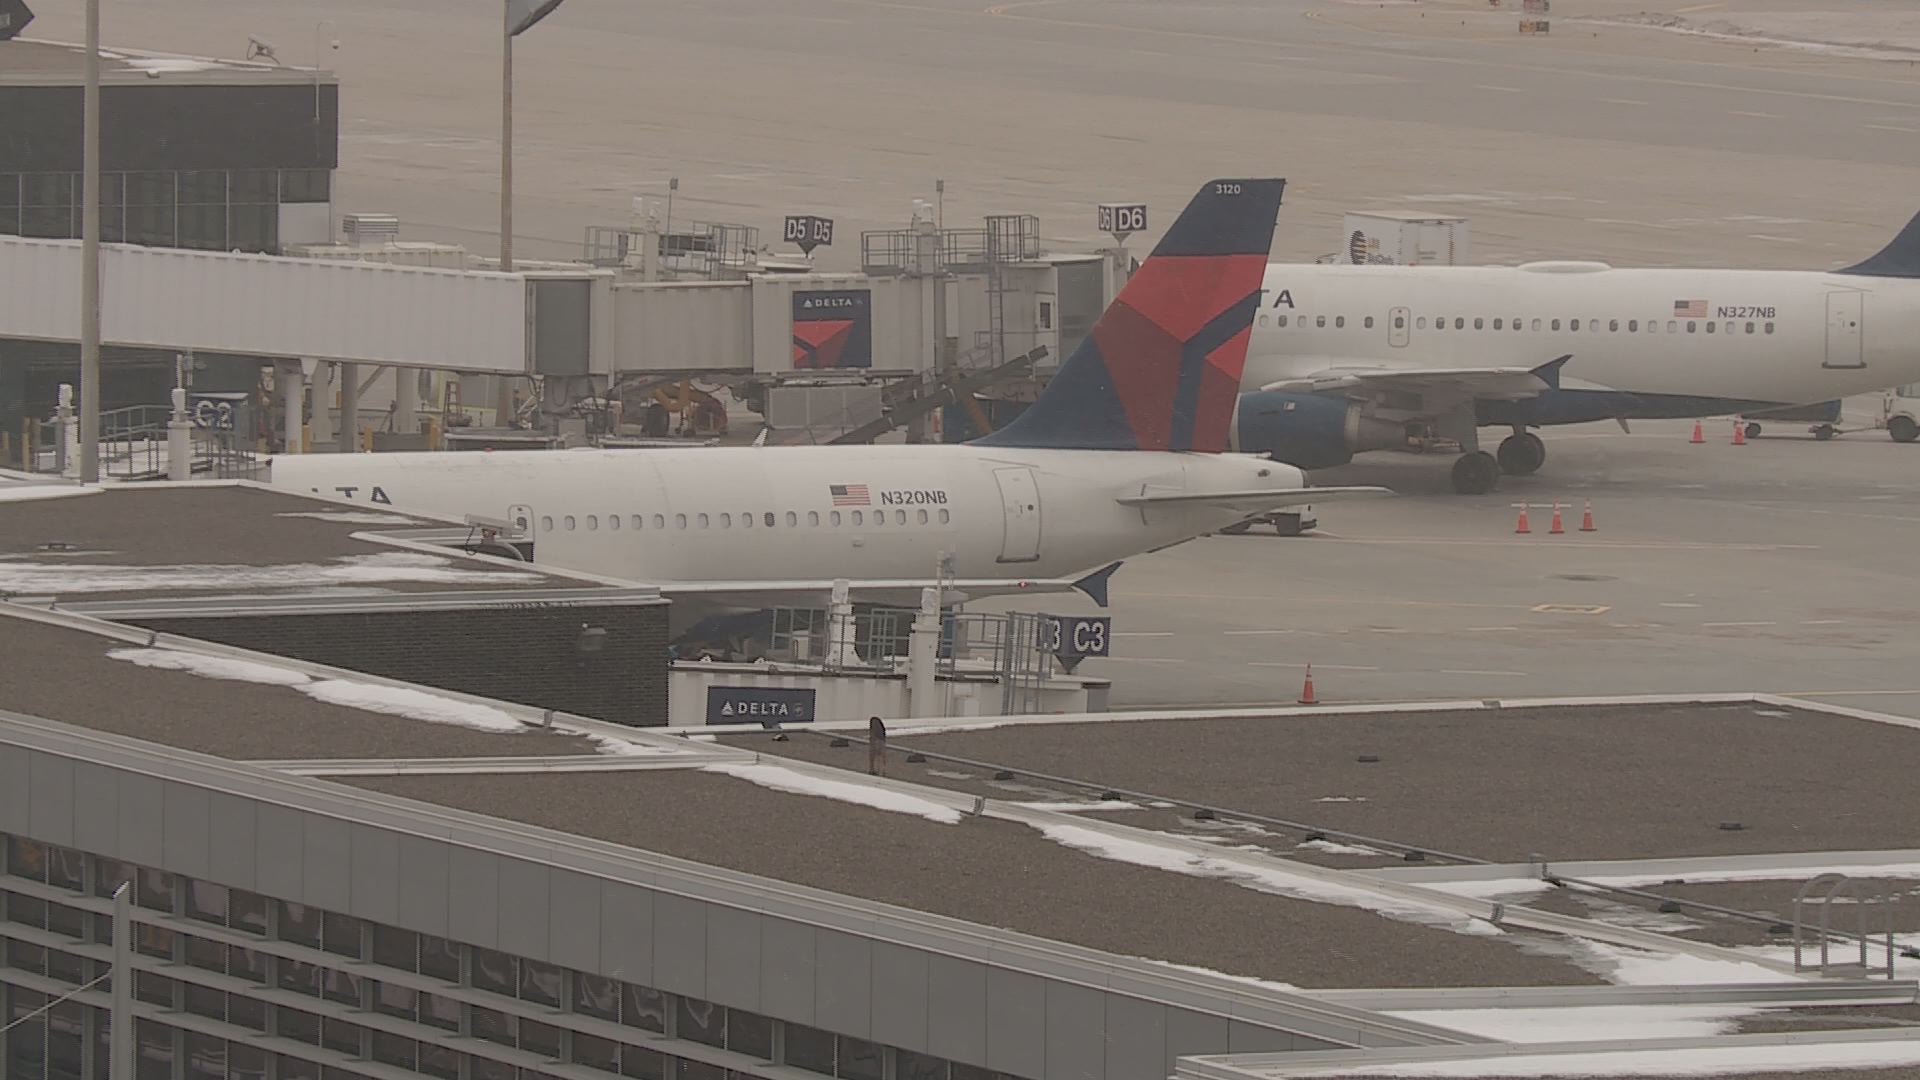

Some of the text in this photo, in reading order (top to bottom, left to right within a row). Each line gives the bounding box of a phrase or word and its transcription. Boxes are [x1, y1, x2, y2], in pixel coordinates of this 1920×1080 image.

[1215, 184, 1241, 194] 3120
[1118, 208, 1144, 230] D6
[787, 219, 806, 239] D5
[813, 220, 831, 242] D5
[815, 299, 852, 307] DELTA
[1717, 306, 1776, 318] N327NB
[196, 400, 232, 428] C2
[881, 490, 948, 505] N320NB
[1073, 621, 1104, 652] C3
[737, 701, 788, 716] DELTA
